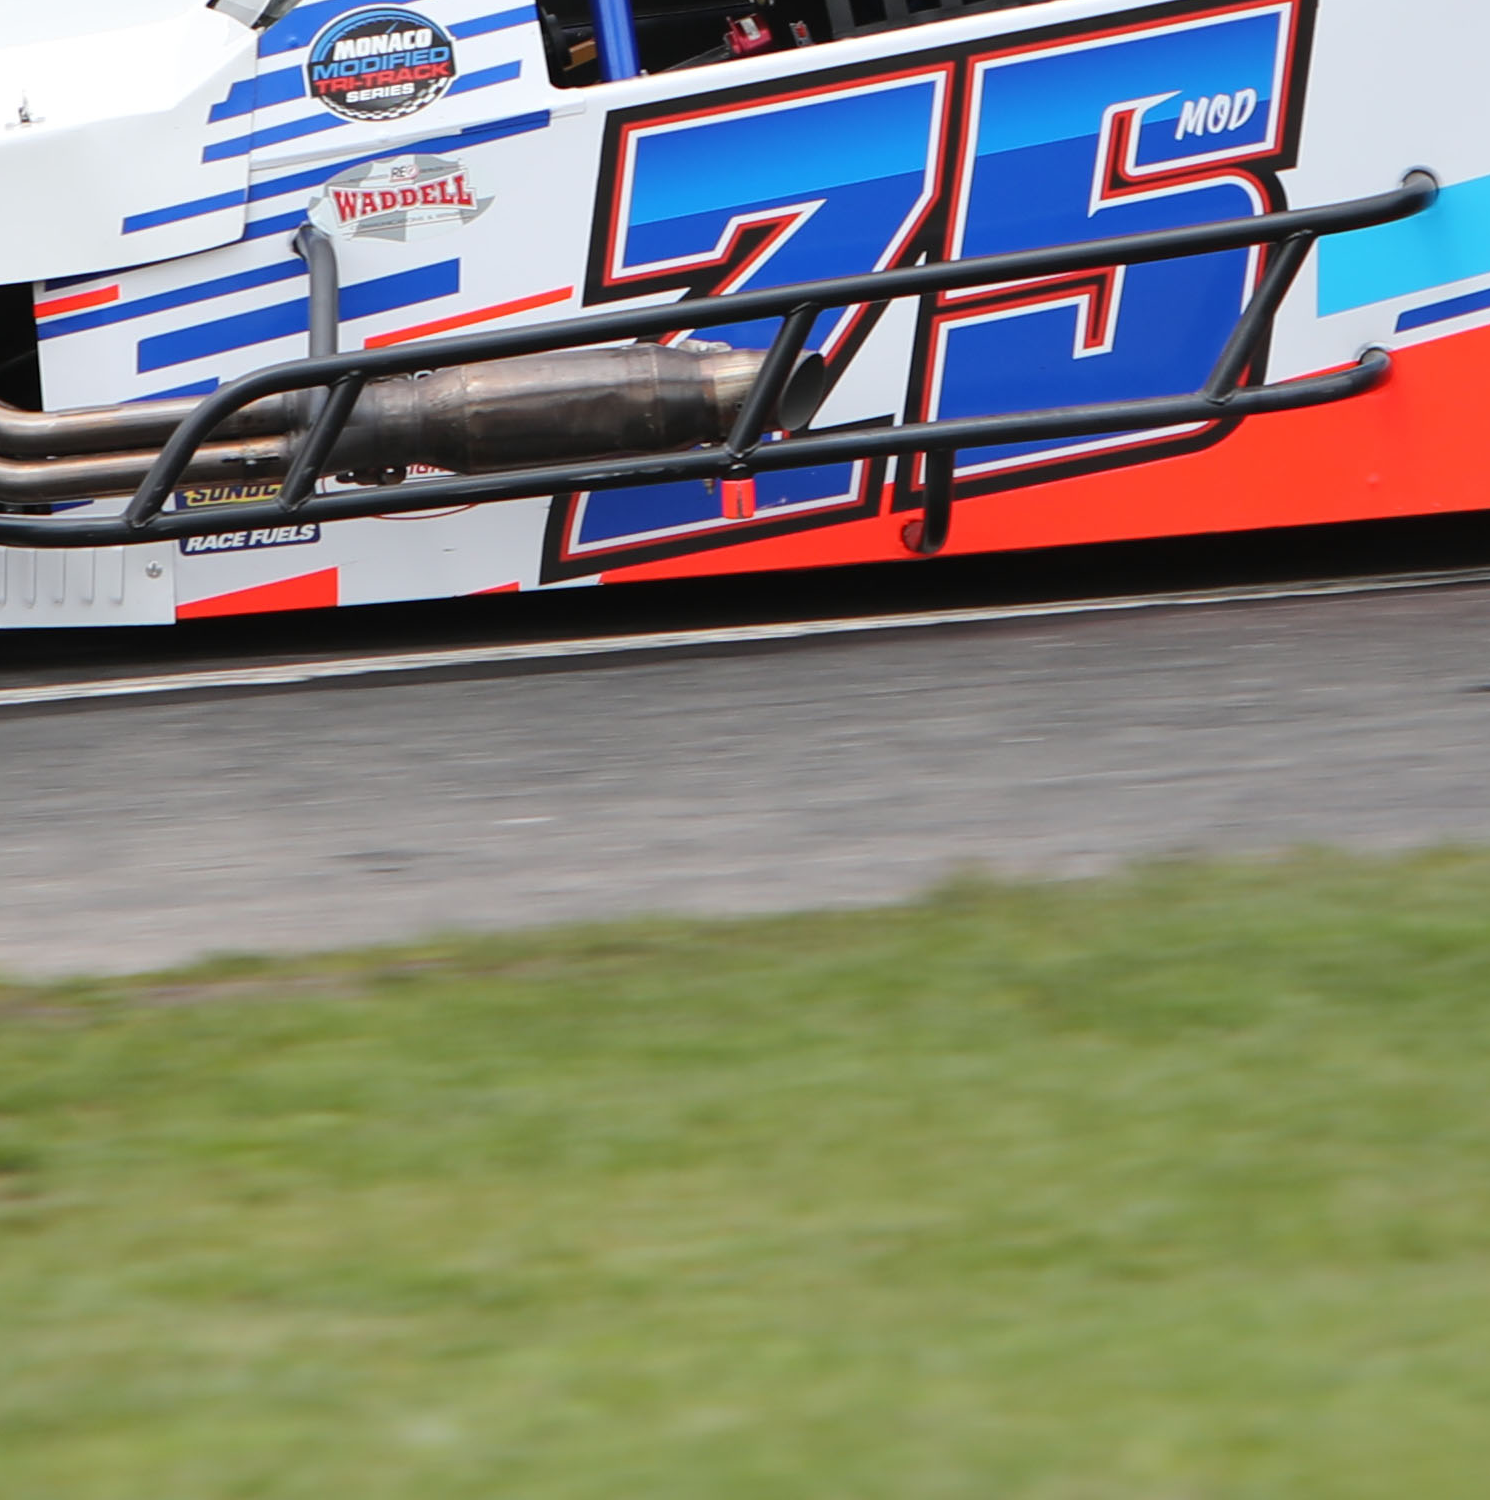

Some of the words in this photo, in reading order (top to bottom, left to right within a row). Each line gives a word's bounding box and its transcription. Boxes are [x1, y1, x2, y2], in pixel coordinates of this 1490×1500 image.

[333, 28, 433, 61] MONACO
[313, 47, 450, 80] MODIFIED
[314, 61, 452, 94] TRI-TRACK
[345, 83, 415, 103] SERIES
[1174, 88, 1258, 141] MOD
[333, 175, 473, 223] WADDELL
[185, 530, 248, 552] RACE
[248, 523, 316, 546] FUELS
